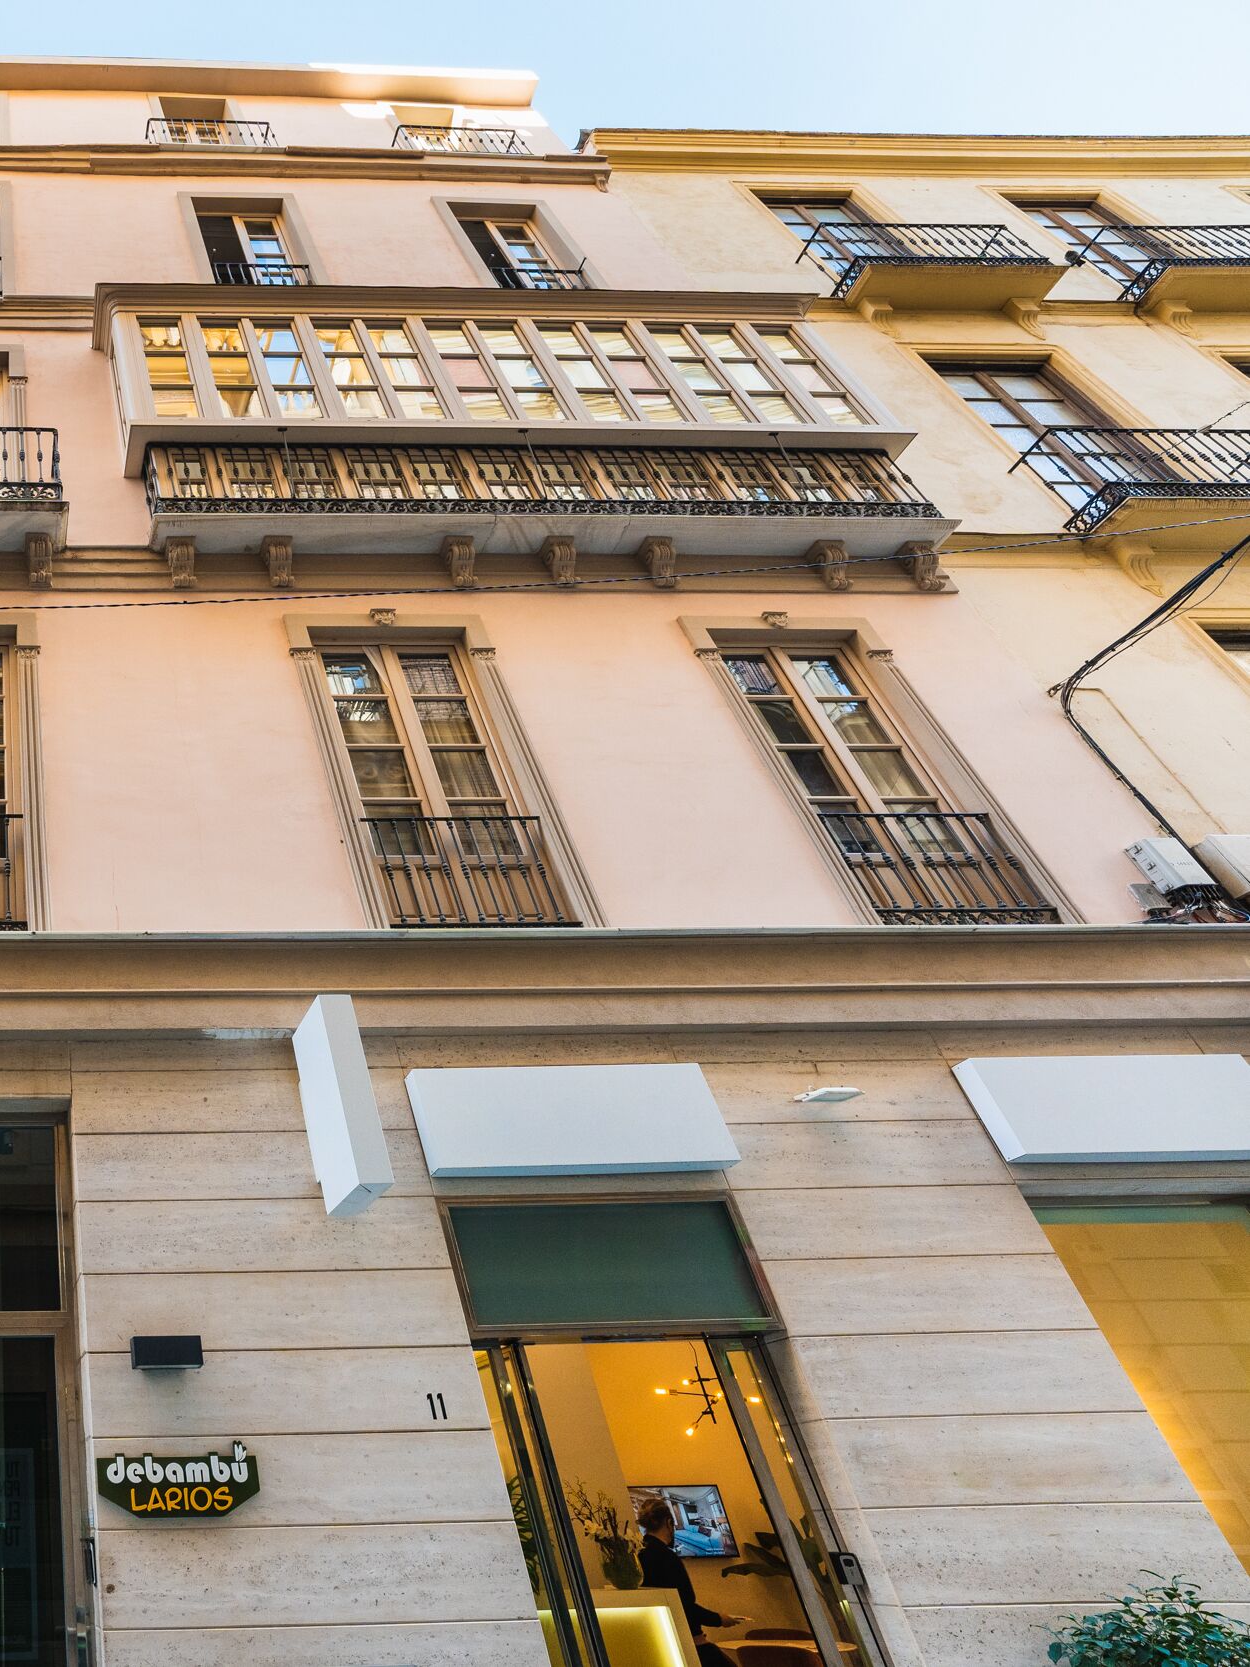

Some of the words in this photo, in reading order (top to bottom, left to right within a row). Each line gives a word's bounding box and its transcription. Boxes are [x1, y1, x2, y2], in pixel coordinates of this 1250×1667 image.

[426, 1393, 448, 1420] 11
[106, 1443, 249, 1484] debambú
[130, 1486, 234, 1512] LARIOS
